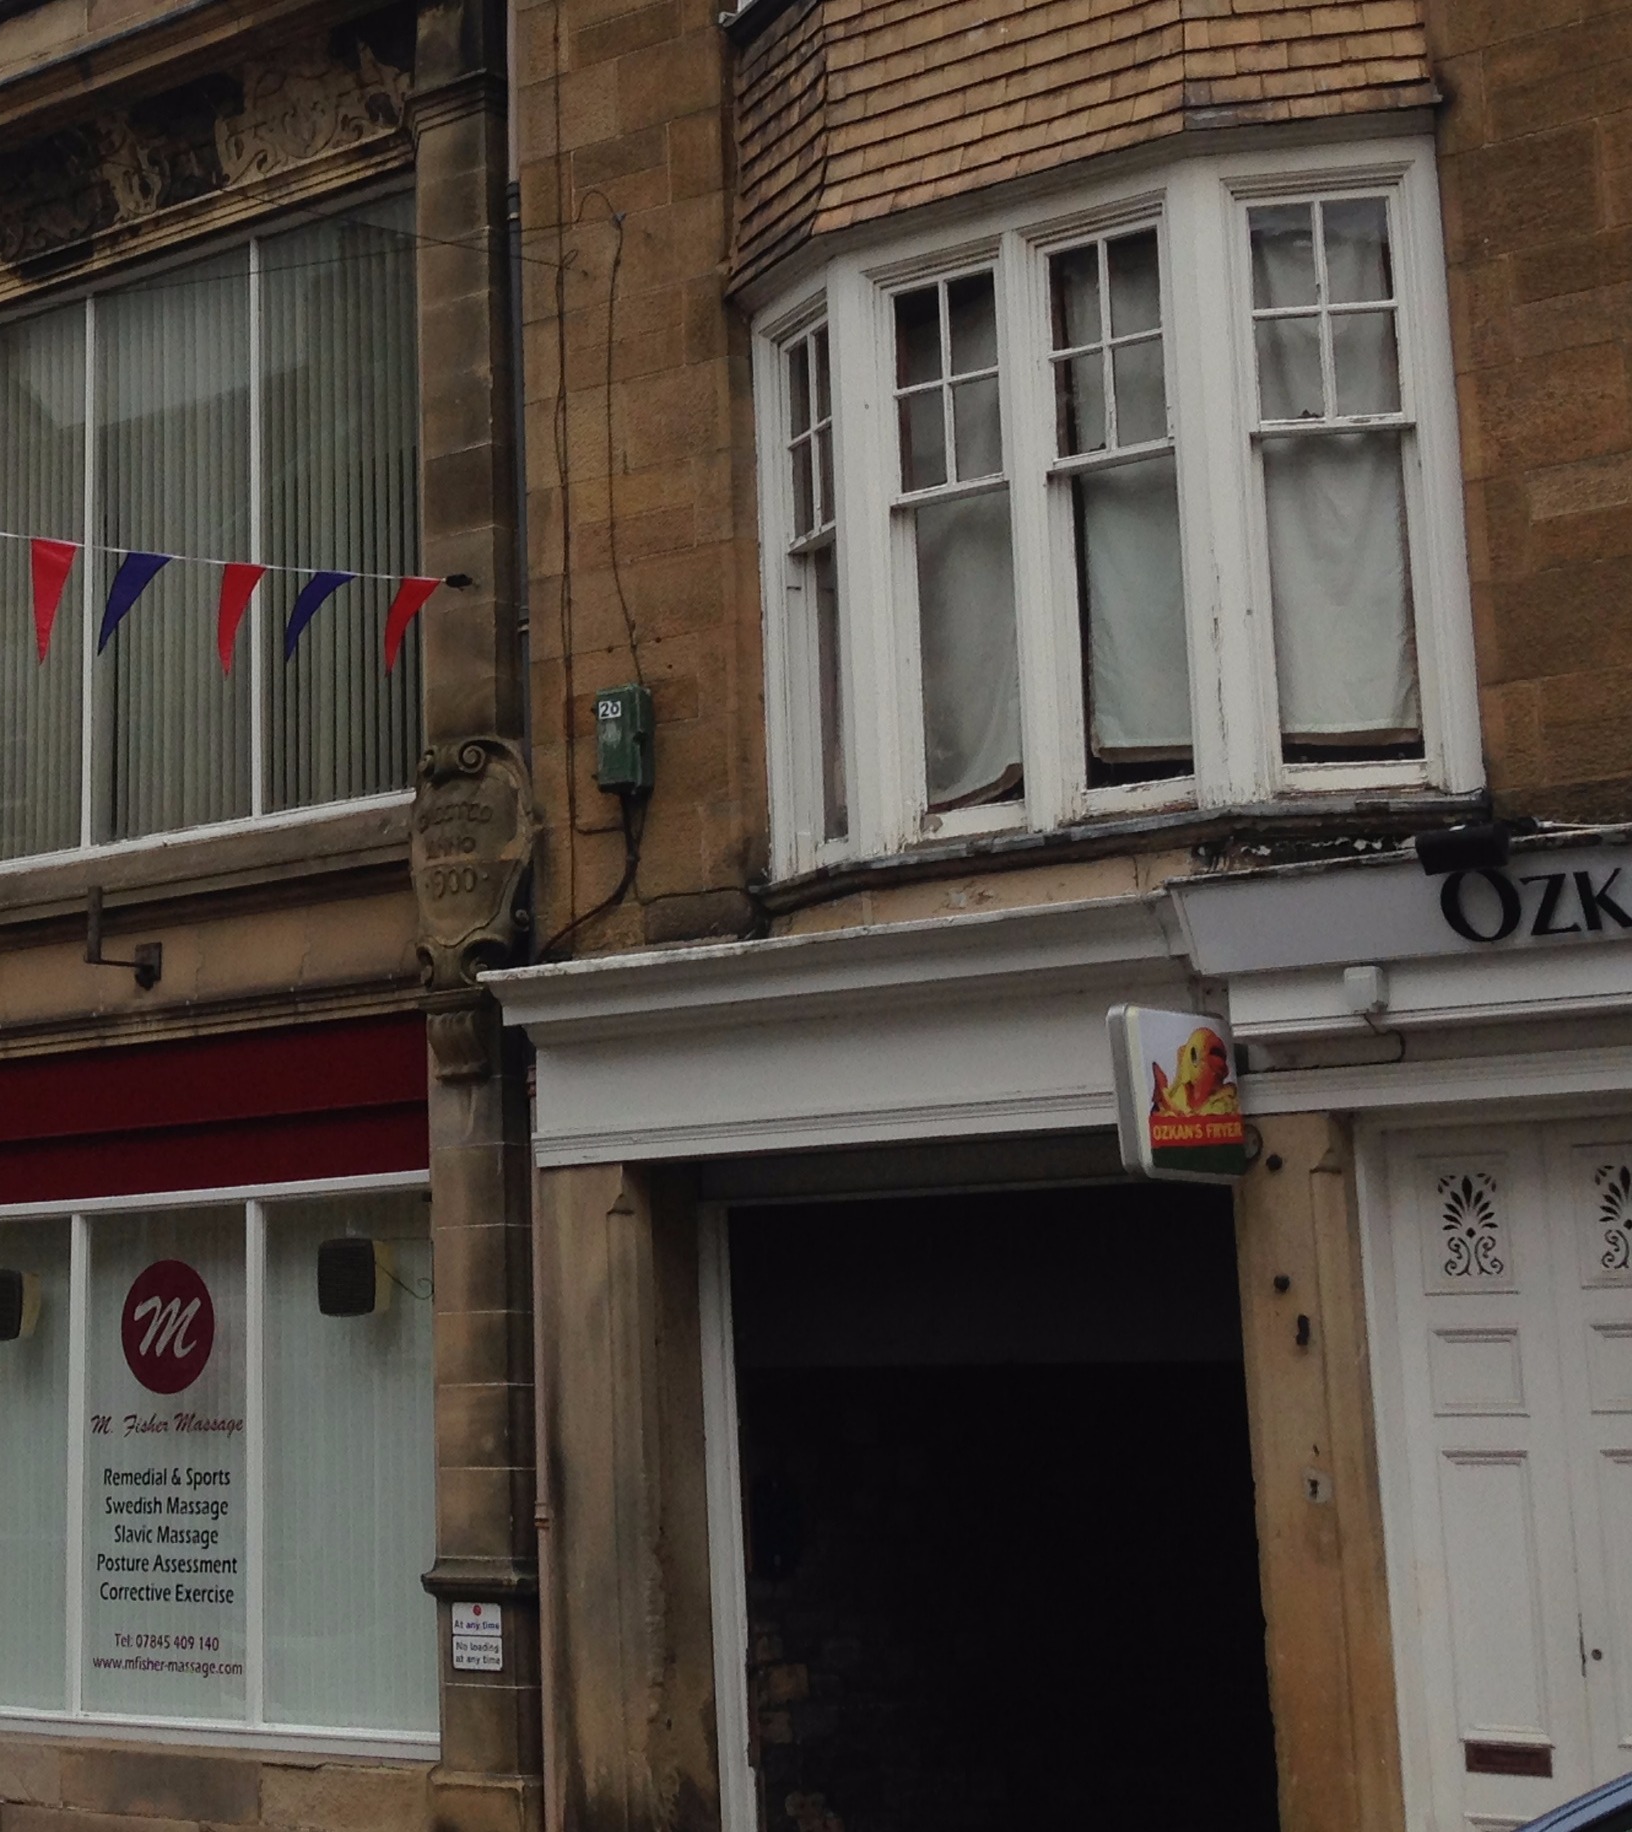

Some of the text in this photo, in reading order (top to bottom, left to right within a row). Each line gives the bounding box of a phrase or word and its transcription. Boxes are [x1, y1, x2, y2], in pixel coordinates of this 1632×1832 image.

[600, 702, 620, 718] 20
[1440, 867, 1632, 942] OZK
[1153, 1122, 1243, 1140] OZKAN'S FRYER
[134, 1296, 201, 1358] M
[124, 1413, 169, 1437] Fisher
[174, 1412, 244, 1438] Massage
[103, 1467, 231, 1491] Remedial & Sports
[105, 1496, 229, 1520] Swedish Massage
[114, 1525, 219, 1549] Slavic Massage
[97, 1553, 238, 1574] Posture Assessment
[100, 1582, 234, 1604] Corrective Exercise
[454, 1620, 499, 1630] At any time
[135, 1634, 171, 1649] 07845
[173, 1635, 195, 1650] 409
[199, 1636, 220, 1651] 140
[456, 1641, 499, 1654] No loading
[93, 1656, 243, 1678] www.mfisher-massage.com
